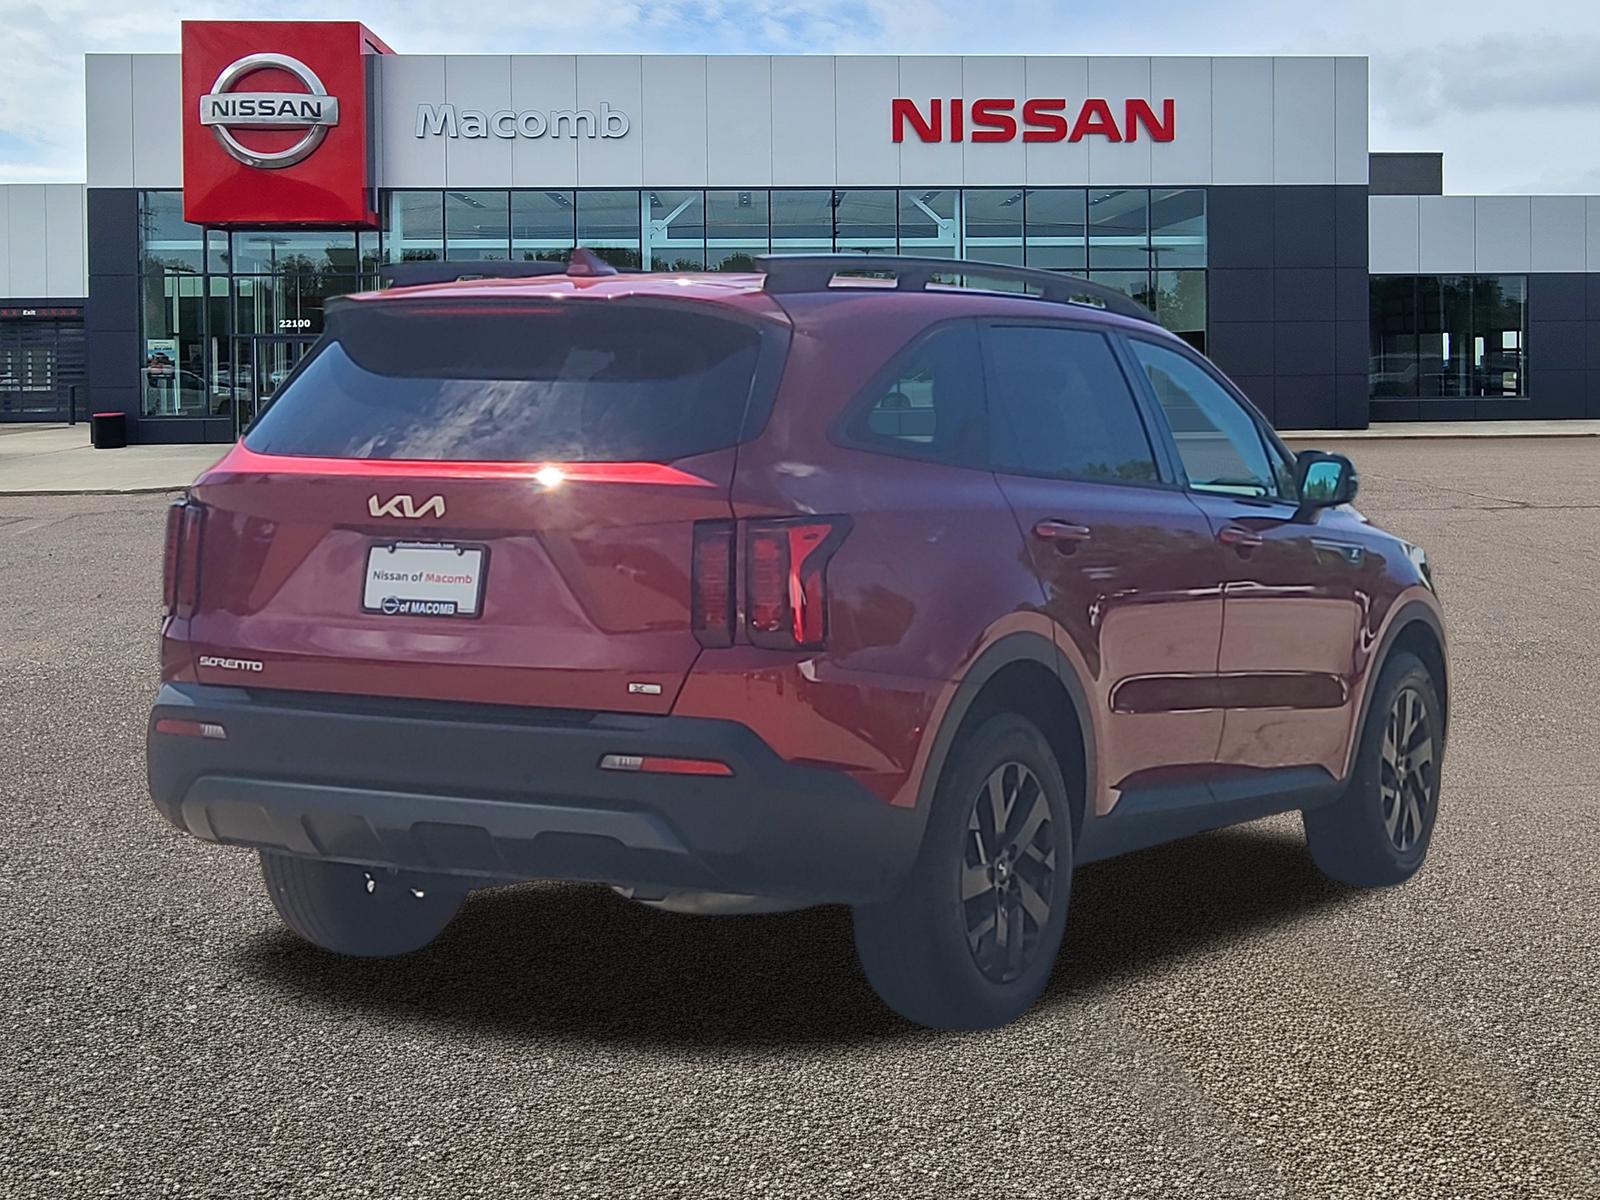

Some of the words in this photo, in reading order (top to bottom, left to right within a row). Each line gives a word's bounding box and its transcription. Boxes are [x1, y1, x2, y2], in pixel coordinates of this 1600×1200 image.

[211, 99, 322, 118] NISSAN
[415, 101, 631, 139] Macomb
[892, 98, 1175, 143] NISSAN
[279, 319, 311, 328] 22100
[367, 494, 446, 519] KIA
[372, 570, 409, 582] Nissan
[411, 571, 424, 582] of
[425, 573, 473, 584] Macomb
[399, 601, 411, 614] of
[410, 601, 456, 615] MACOMB
[199, 655, 263, 672] SORENTO
